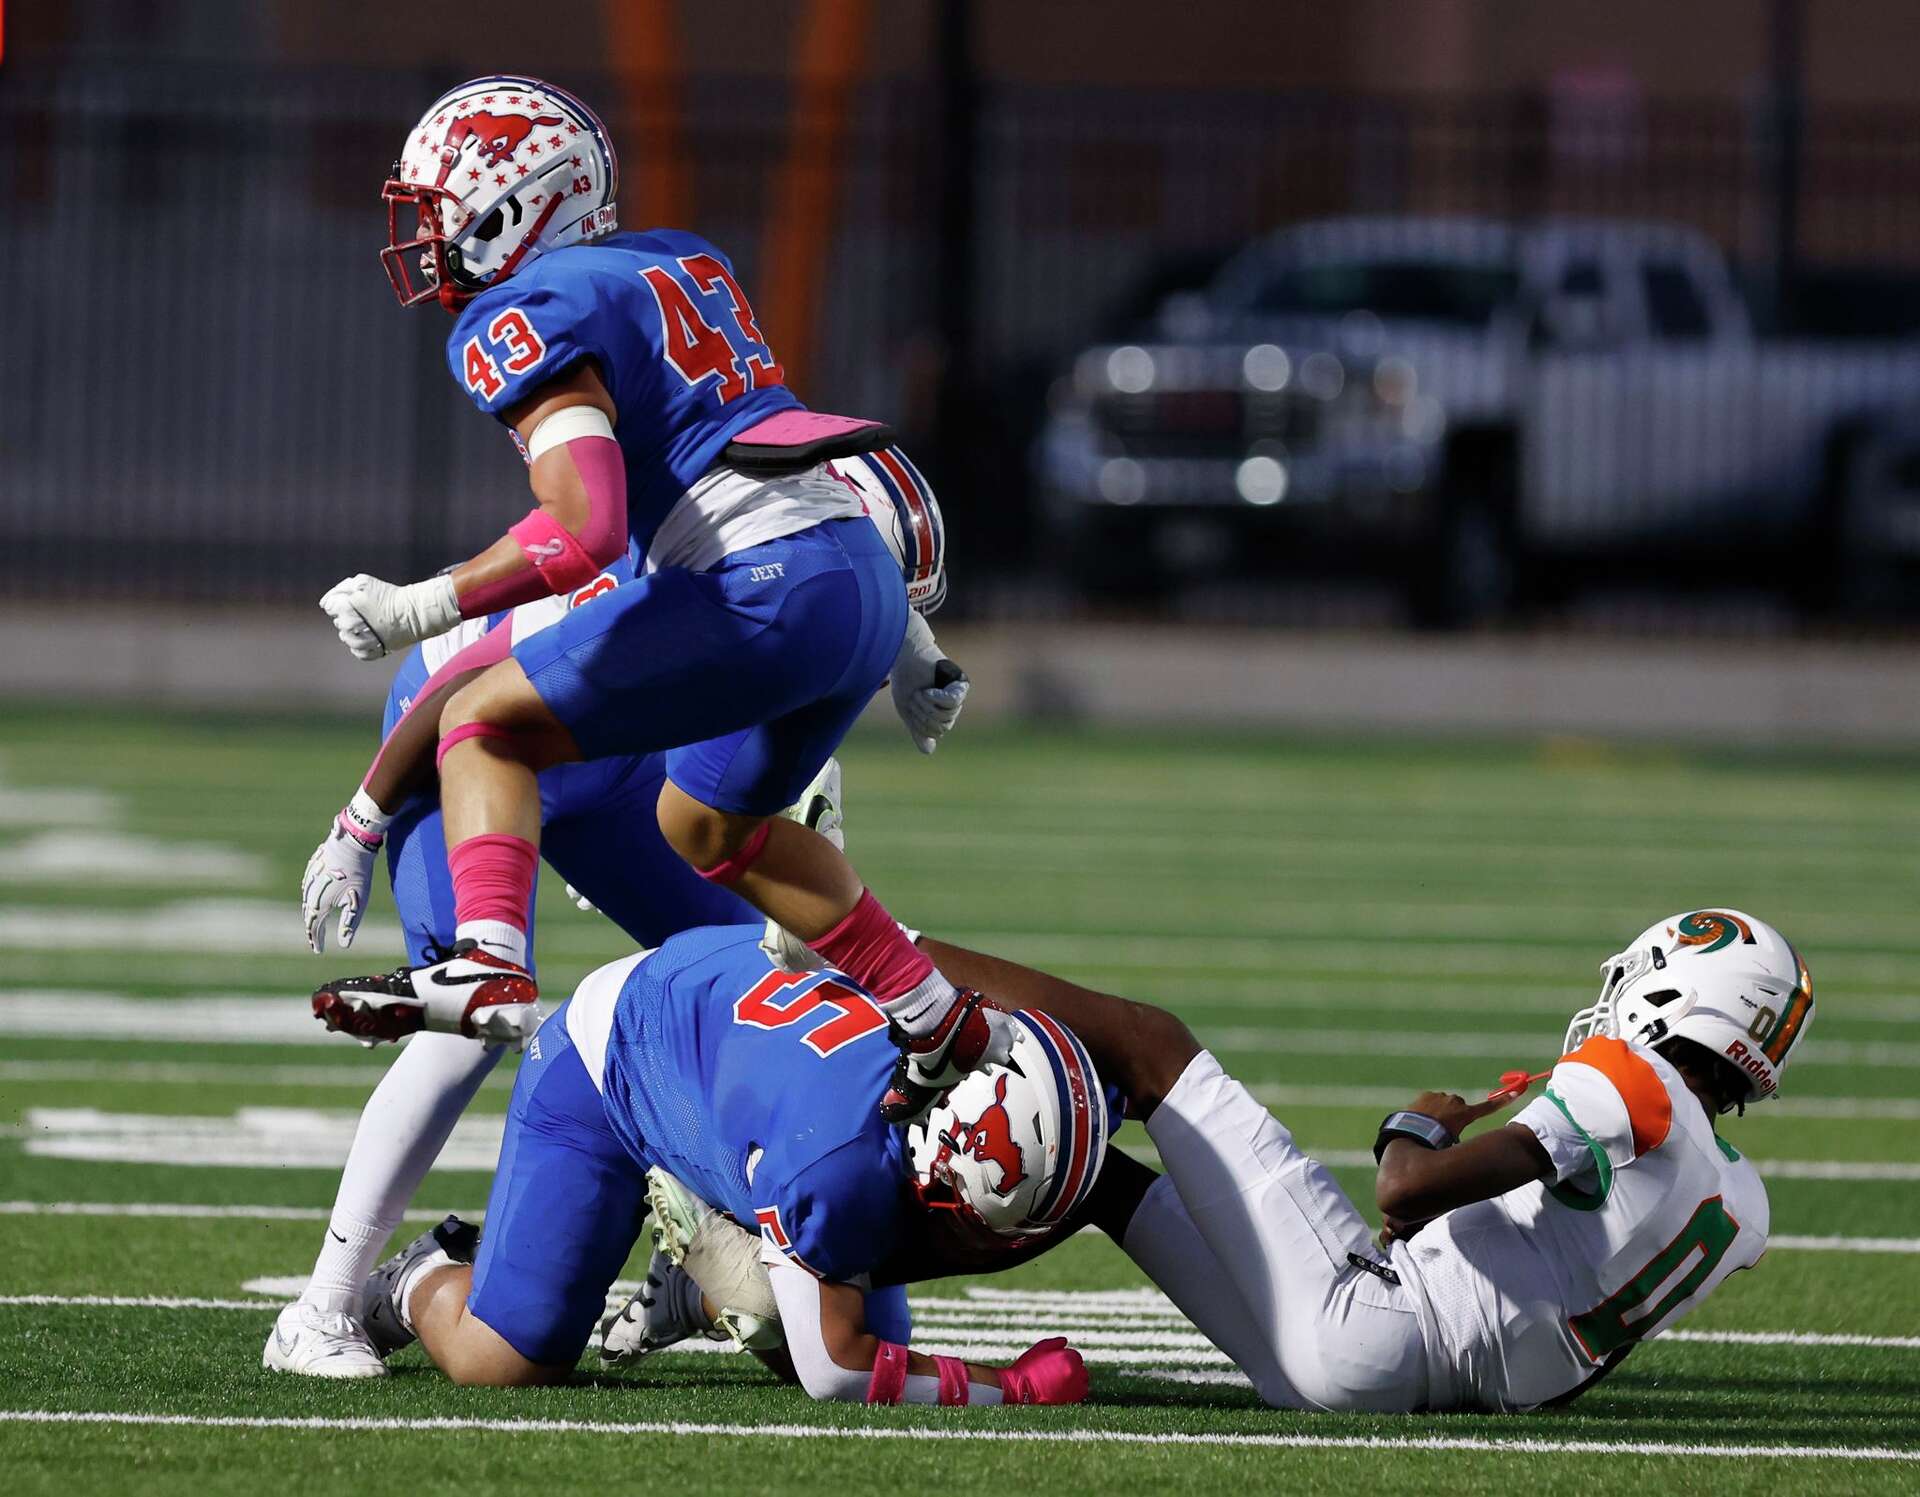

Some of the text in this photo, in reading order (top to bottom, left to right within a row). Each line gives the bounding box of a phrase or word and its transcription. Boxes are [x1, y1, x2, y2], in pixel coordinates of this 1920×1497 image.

[572, 174, 592, 195] 43
[463, 306, 548, 403] 43
[638, 253, 785, 406] 43
[750, 562, 785, 582] JEFF
[732, 968, 891, 1059] 5
[1747, 1005, 1777, 1043] 0
[1725, 1039, 1777, 1098] Riddell
[1568, 1192, 1741, 1362] 0
